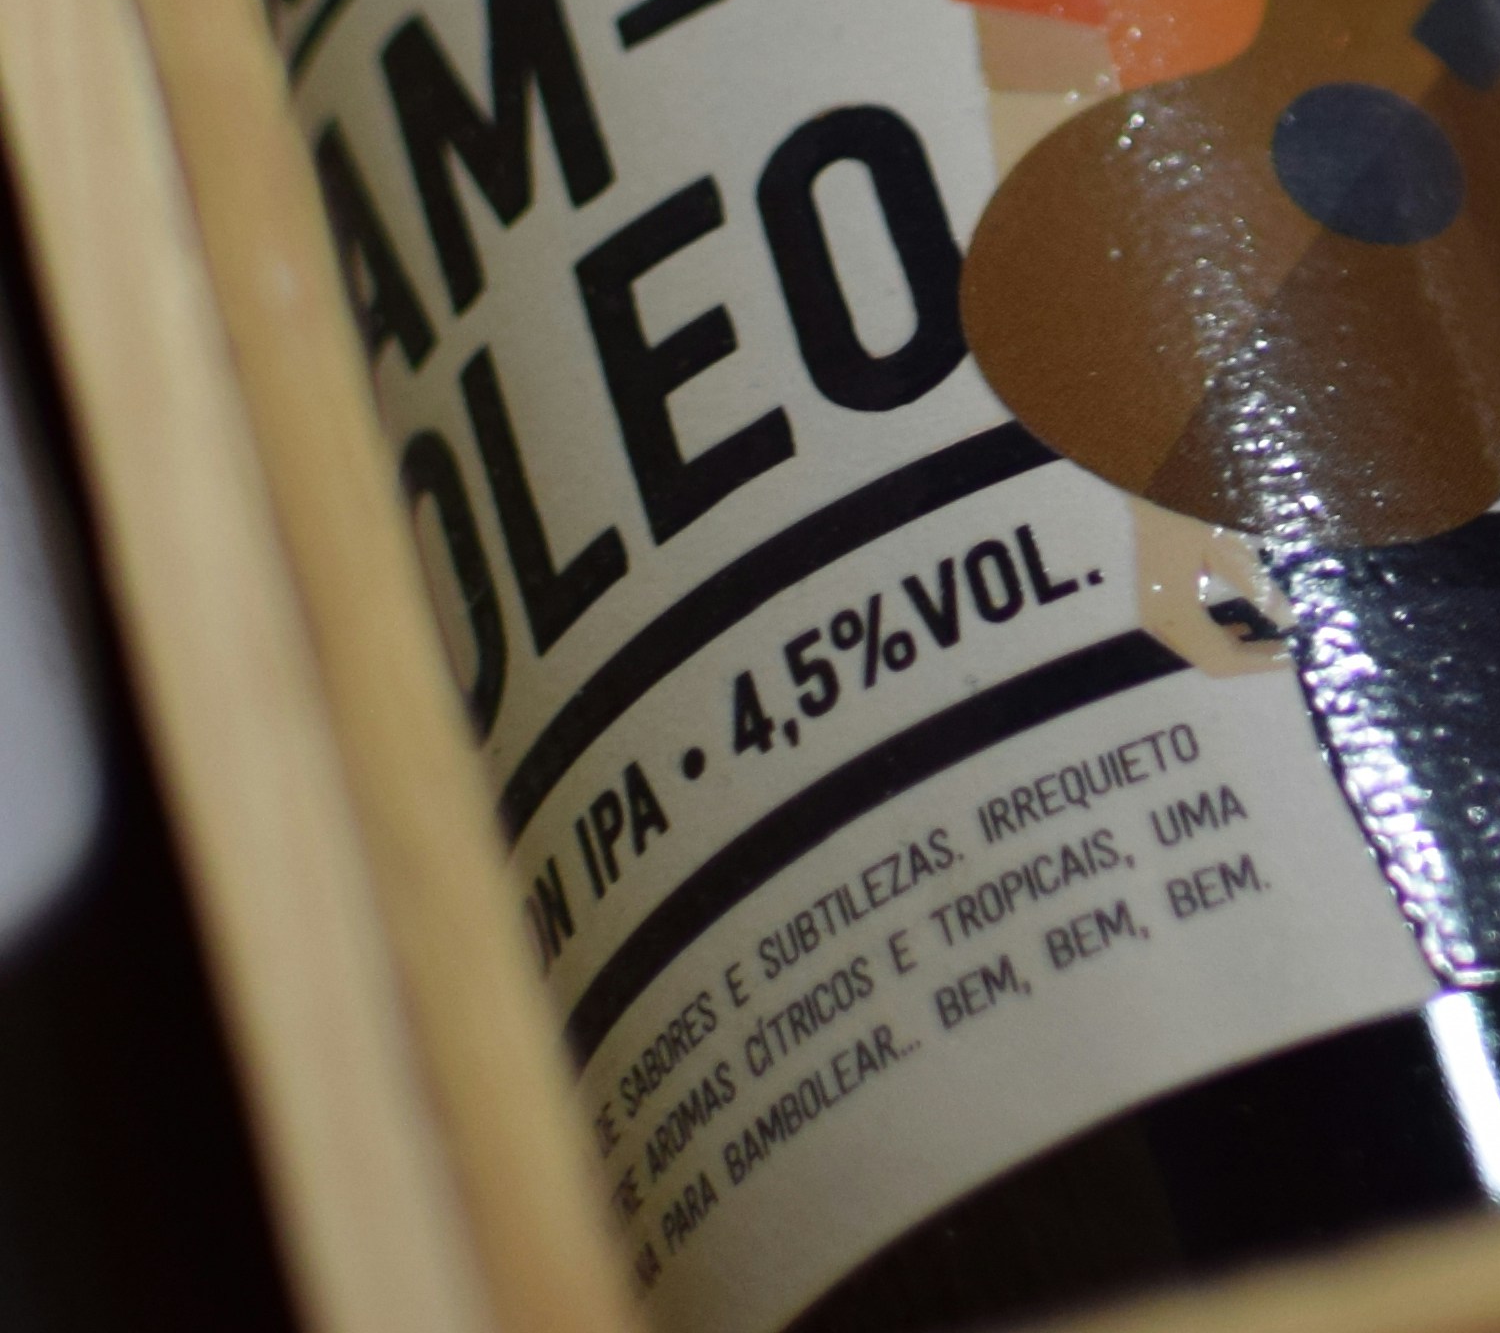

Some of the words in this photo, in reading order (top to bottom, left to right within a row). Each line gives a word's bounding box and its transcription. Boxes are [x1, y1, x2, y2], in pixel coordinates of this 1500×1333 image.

[400, 103, 970, 745] OLEO
[574, 760, 671, 900] IPA
[618, 990, 718, 1119] SABORES
[724, 961, 750, 1009] E
[757, 826, 965, 981] SUBTILEZAS.
[976, 722, 1201, 845] IRREQUIETO
[646, 1061, 738, 1183] AROMAS
[743, 955, 875, 1080] CÍTRICOS
[889, 927, 918, 975] E
[929, 826, 1137, 951] TROPICAIS,
[1147, 783, 1249, 849] UMA
[660, 1170, 720, 1256] PARA
[933, 953, 1032, 1030] BEM,
[1044, 900, 1152, 971] BEM,
[1165, 853, 1272, 921] BEM.
